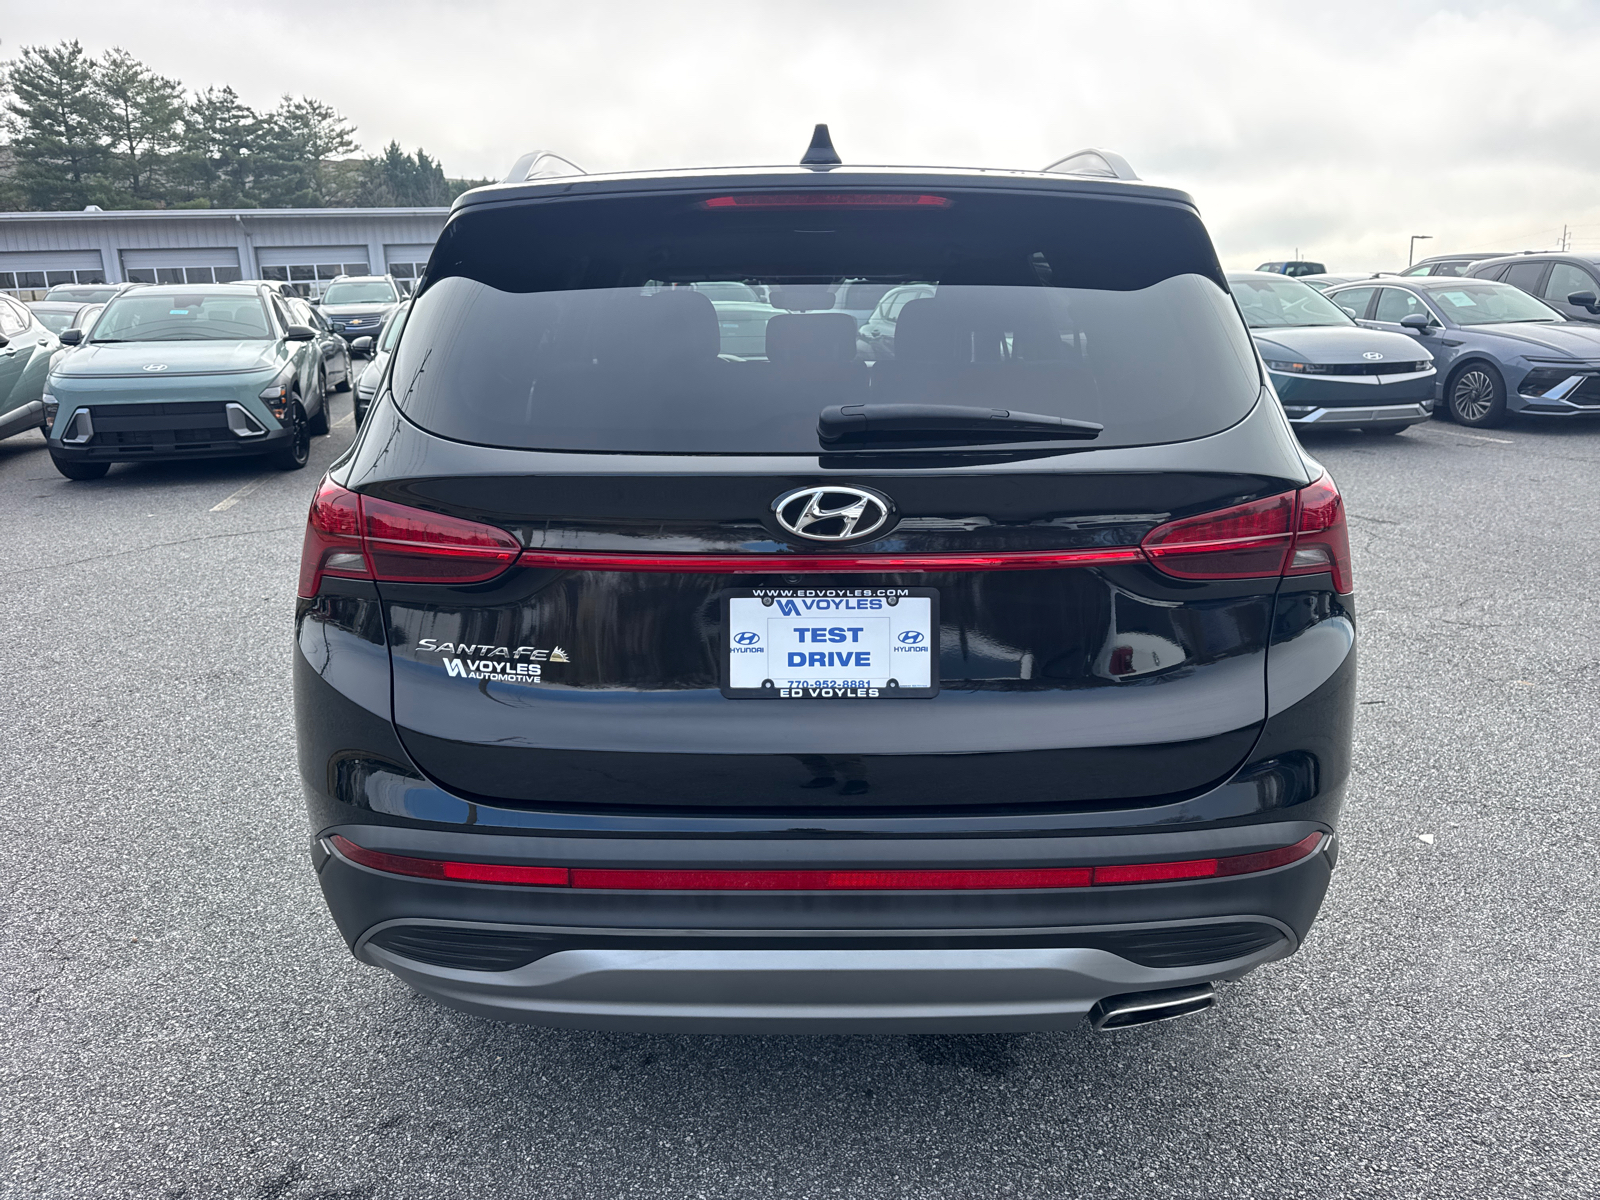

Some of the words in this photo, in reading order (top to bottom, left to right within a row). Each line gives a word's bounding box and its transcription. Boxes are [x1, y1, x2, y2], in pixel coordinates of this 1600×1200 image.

[752, 589, 909, 597] WWW.EDVOYLES.COM
[801, 599, 883, 610] VOYLES
[793, 627, 864, 643] TEST
[787, 651, 871, 668] DRIVE
[467, 659, 541, 675] VOYLES
[468, 672, 541, 684] AUTOMOTIVE
[787, 680, 871, 689] 770-952-8881
[779, 688, 804, 698] ED
[809, 688, 880, 698] VOYLES
